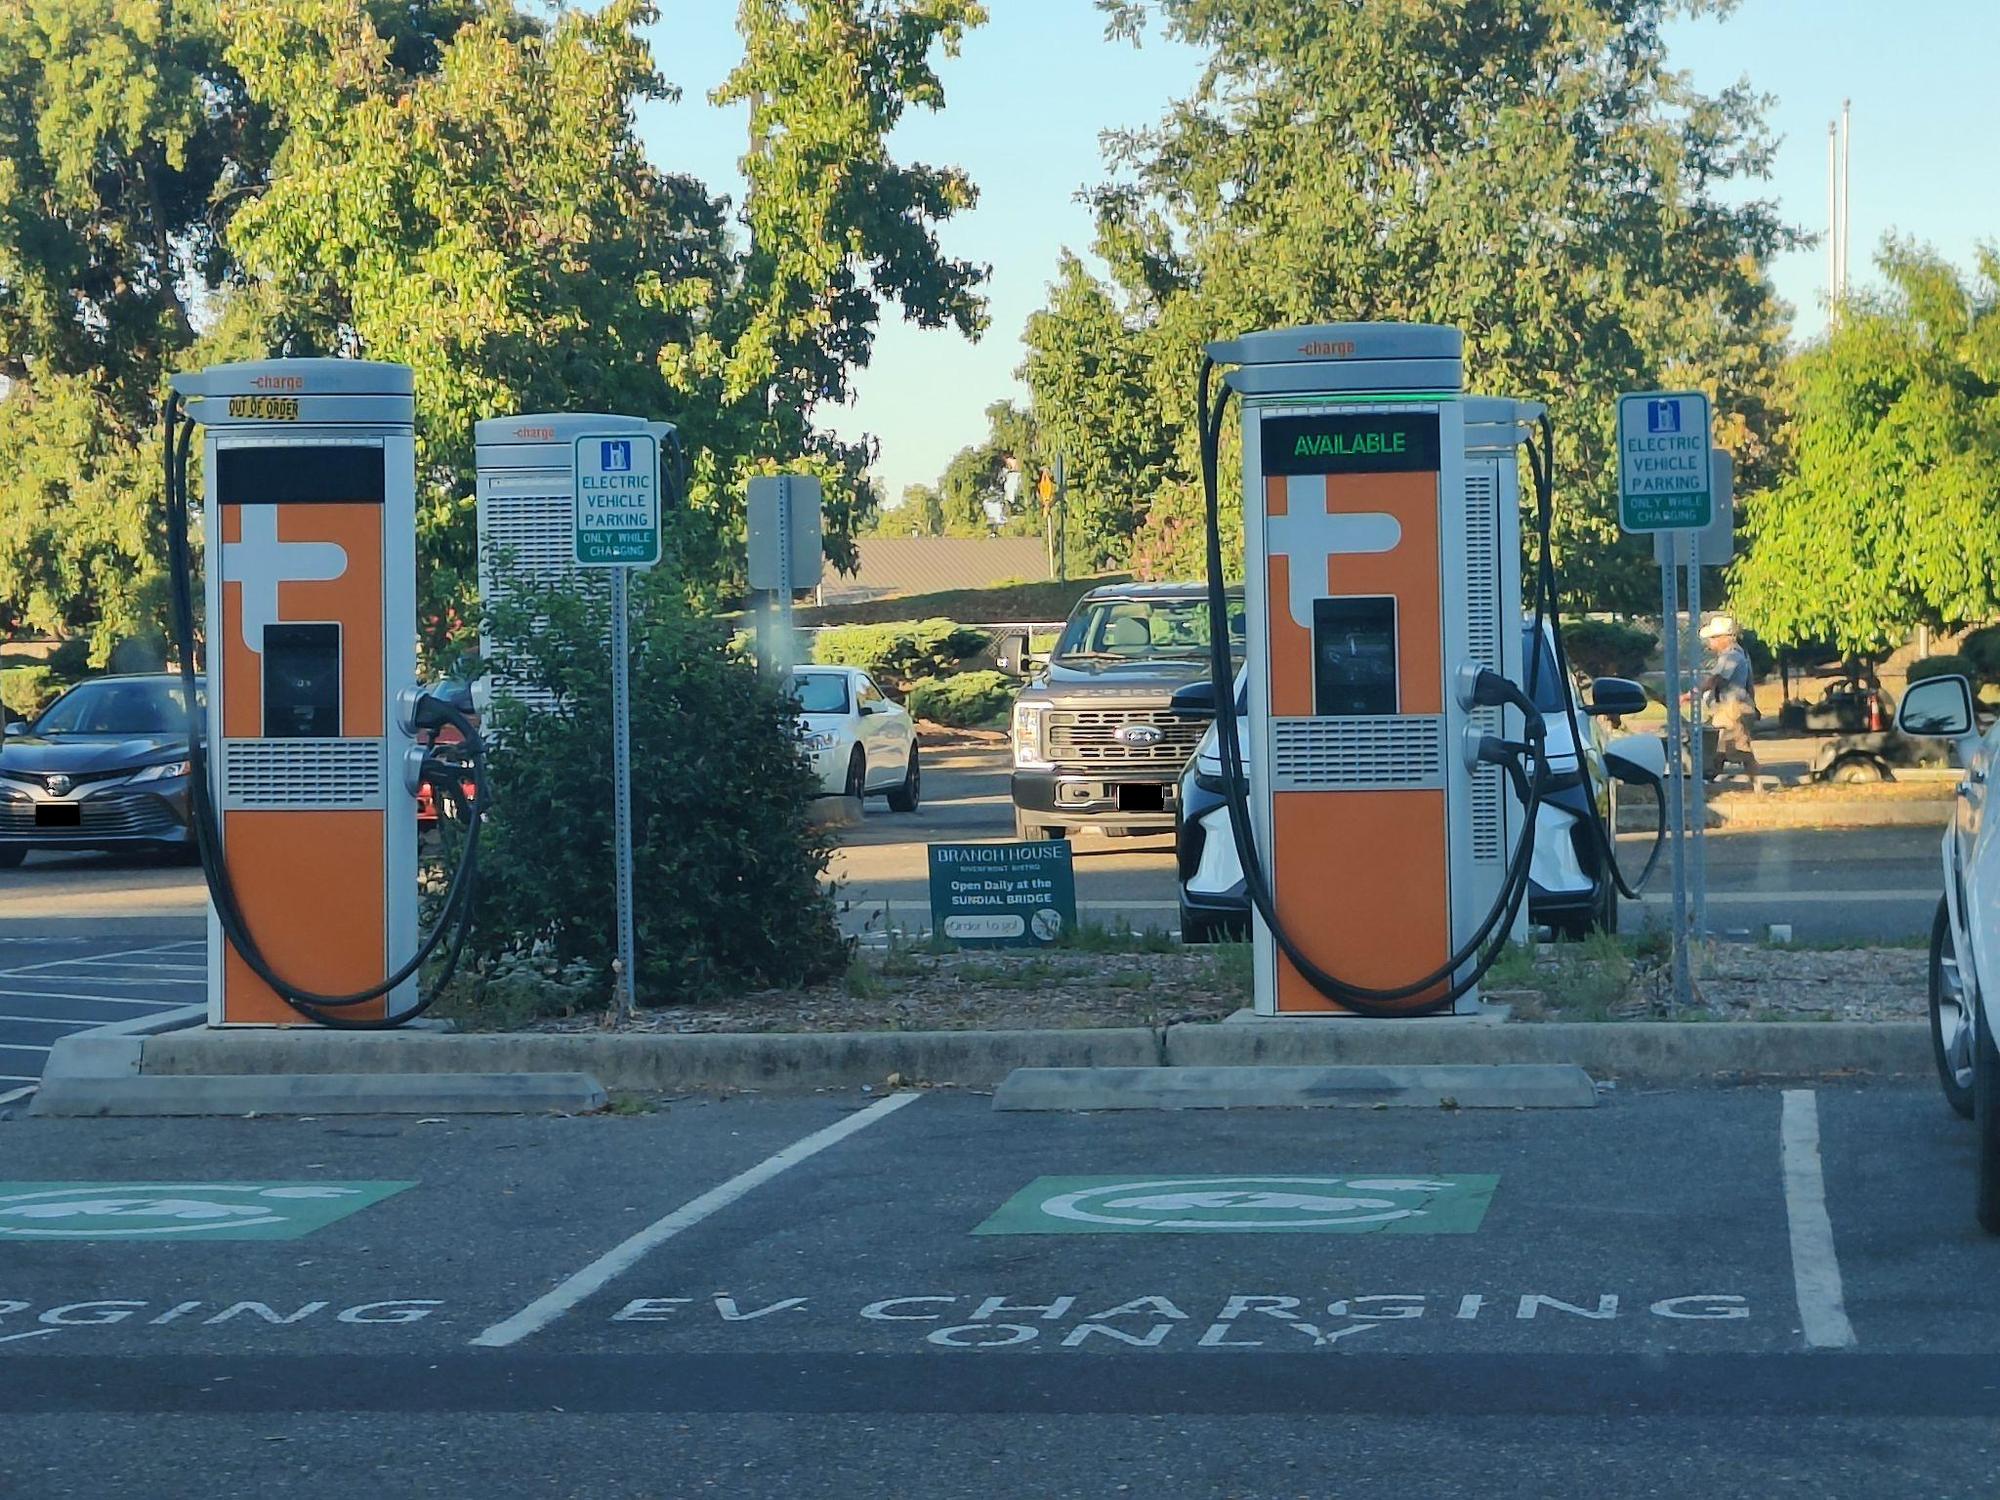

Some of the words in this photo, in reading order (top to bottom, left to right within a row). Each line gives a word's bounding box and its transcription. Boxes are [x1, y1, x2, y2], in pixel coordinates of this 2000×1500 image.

[1306, 340, 1355, 358] charge
[257, 375, 304, 392] charge
[229, 400, 246, 415] OUT
[250, 400, 262, 415] OF
[266, 400, 299, 417] ORDER
[1294, 432, 1406, 455] AVAILABLE
[1628, 436, 1701, 452] ELECTRIC
[1634, 455, 1698, 472] VEHICLE
[582, 476, 649, 489] ELECTRIC
[1632, 476, 1700, 491] PARKING
[587, 494, 646, 508] VEHICLE
[585, 513, 648, 526] PARKING
[583, 533, 612, 543] ONLY
[618, 532, 650, 543] WHILE
[1009, 846, 1064, 861] HOUSE
[951, 881, 981, 892] Open
[984, 880, 1014, 891] Daily
[1016, 880, 1030, 889] at
[1032, 878, 1052, 888] the
[952, 895, 1005, 905] SUNDIAL
[1007, 893, 1053, 904] BRIDGE
[609, 1297, 809, 1321] EV
[859, 1294, 1750, 1321] CHARGING
[926, 1322, 1381, 1347] ONLY
